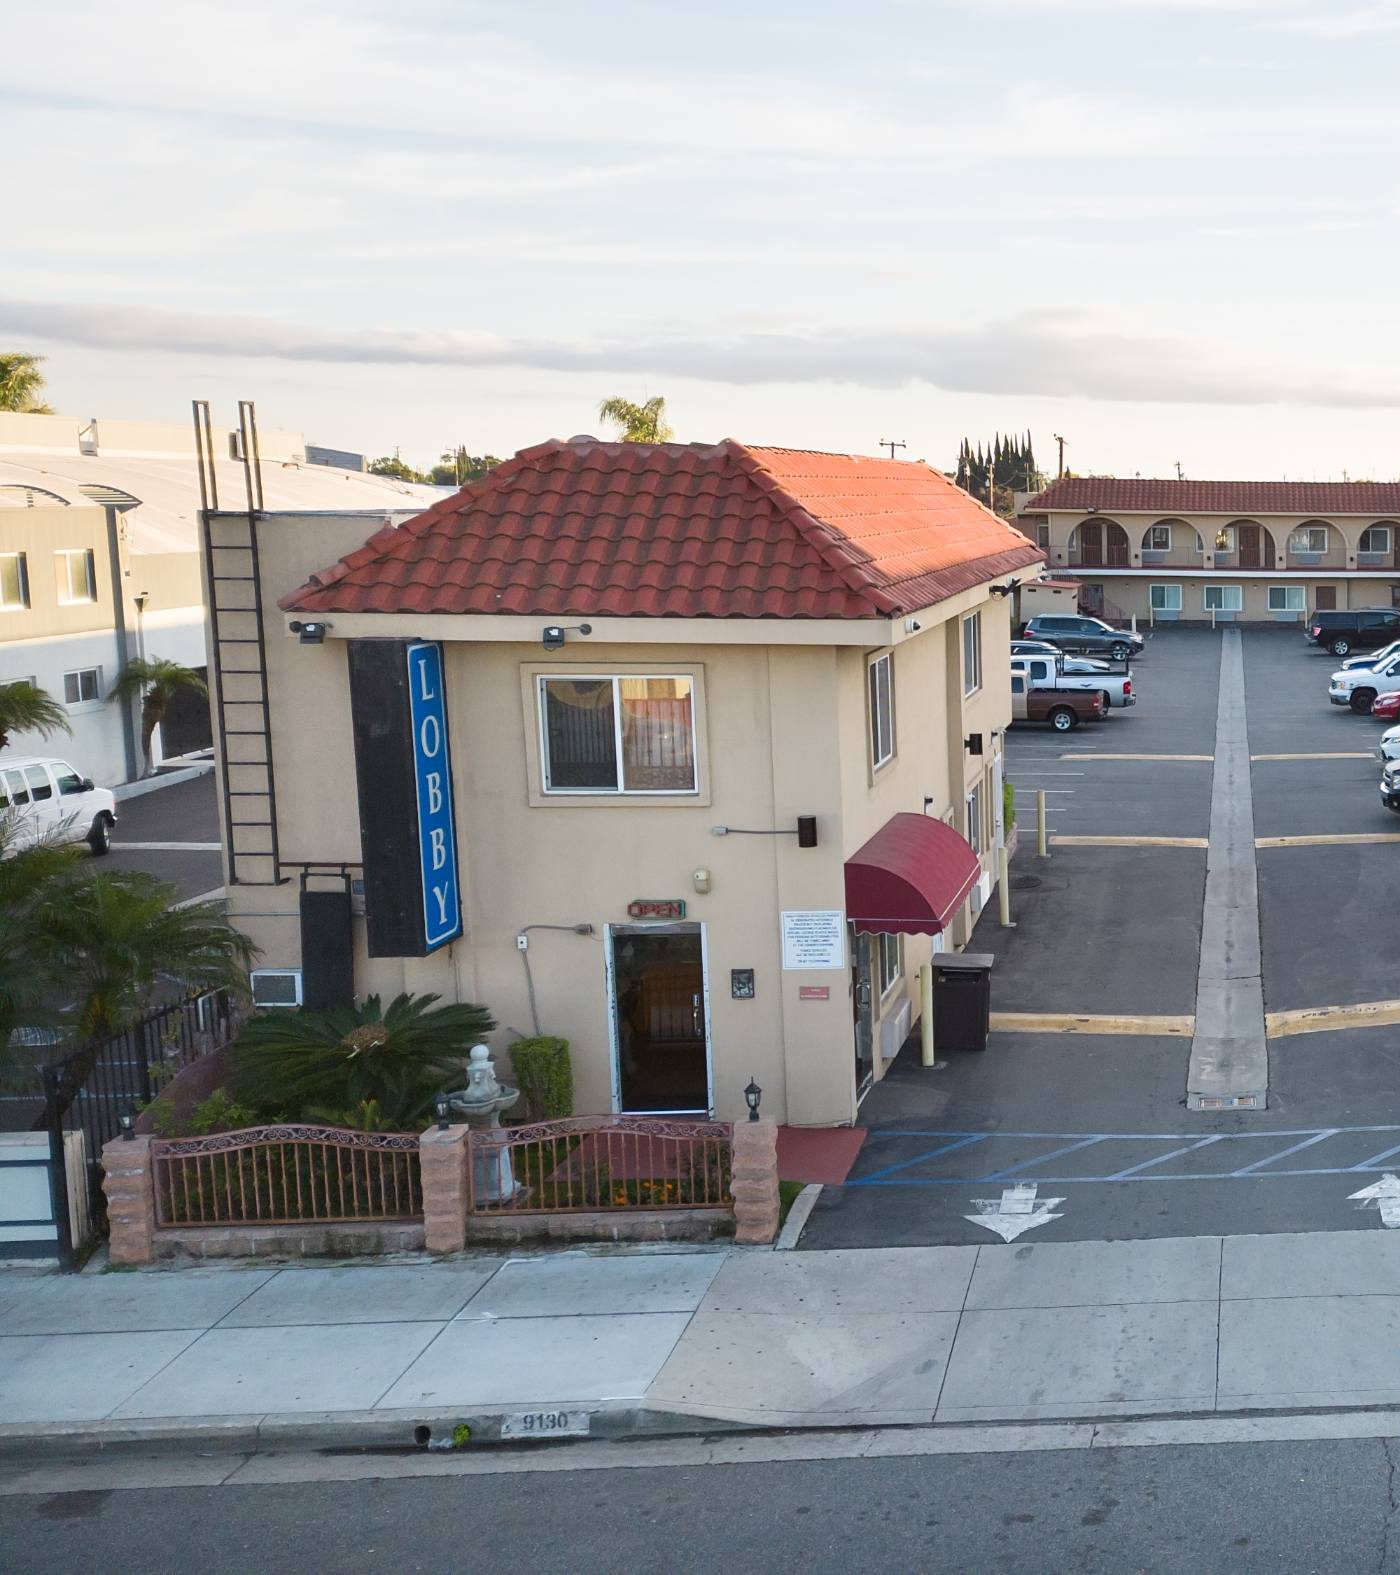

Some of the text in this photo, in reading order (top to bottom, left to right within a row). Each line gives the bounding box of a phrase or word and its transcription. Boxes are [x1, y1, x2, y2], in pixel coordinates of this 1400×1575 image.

[418, 659, 449, 924] LOBBY
[627, 903, 680, 918] OPEN
[523, 1412, 568, 1430] 9130
